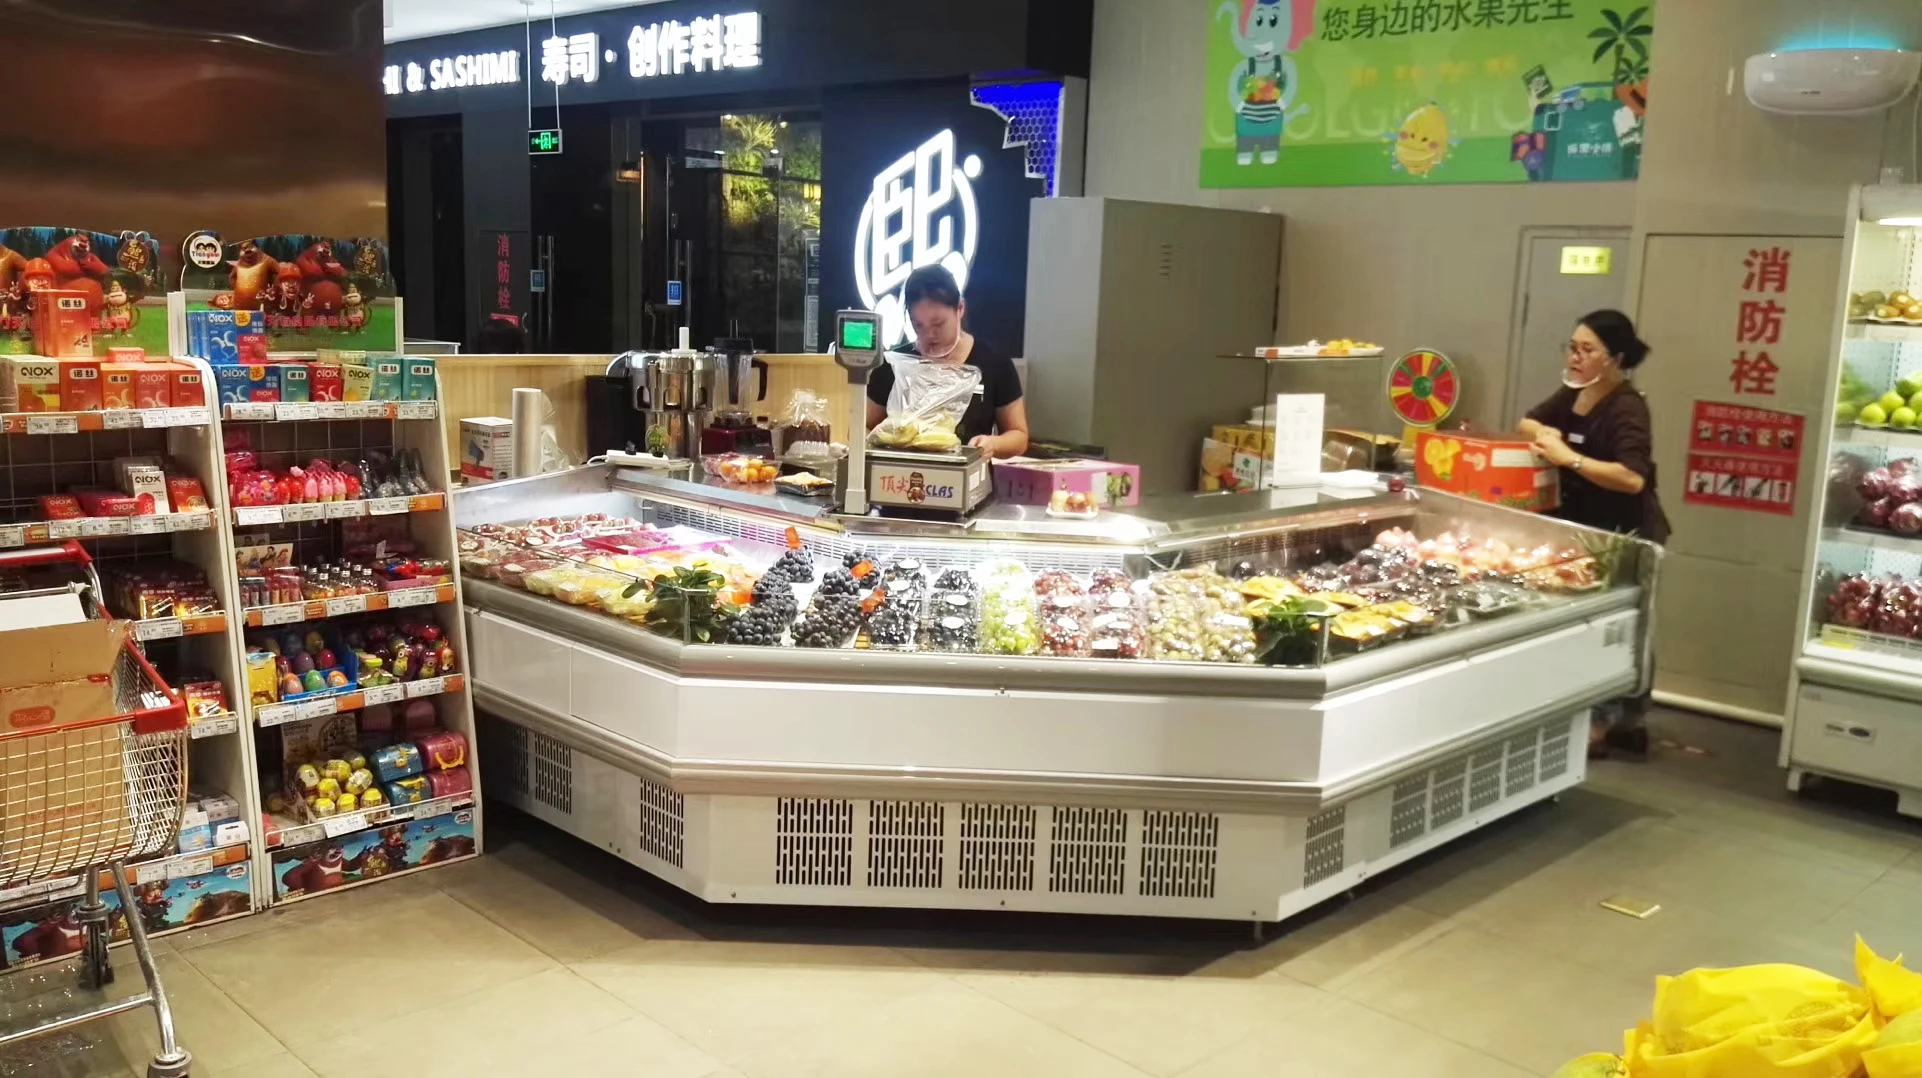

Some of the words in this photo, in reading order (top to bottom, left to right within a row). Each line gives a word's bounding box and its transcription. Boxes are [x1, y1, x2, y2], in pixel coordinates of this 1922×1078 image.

[406, 61, 426, 93] &
[429, 50, 520, 91] SASHIMI
[497, 232, 511, 310] 消防栓
[1728, 246, 1792, 397] 消防栓
[20, 366, 54, 377] NOX
[348, 369, 371, 379] NOX
